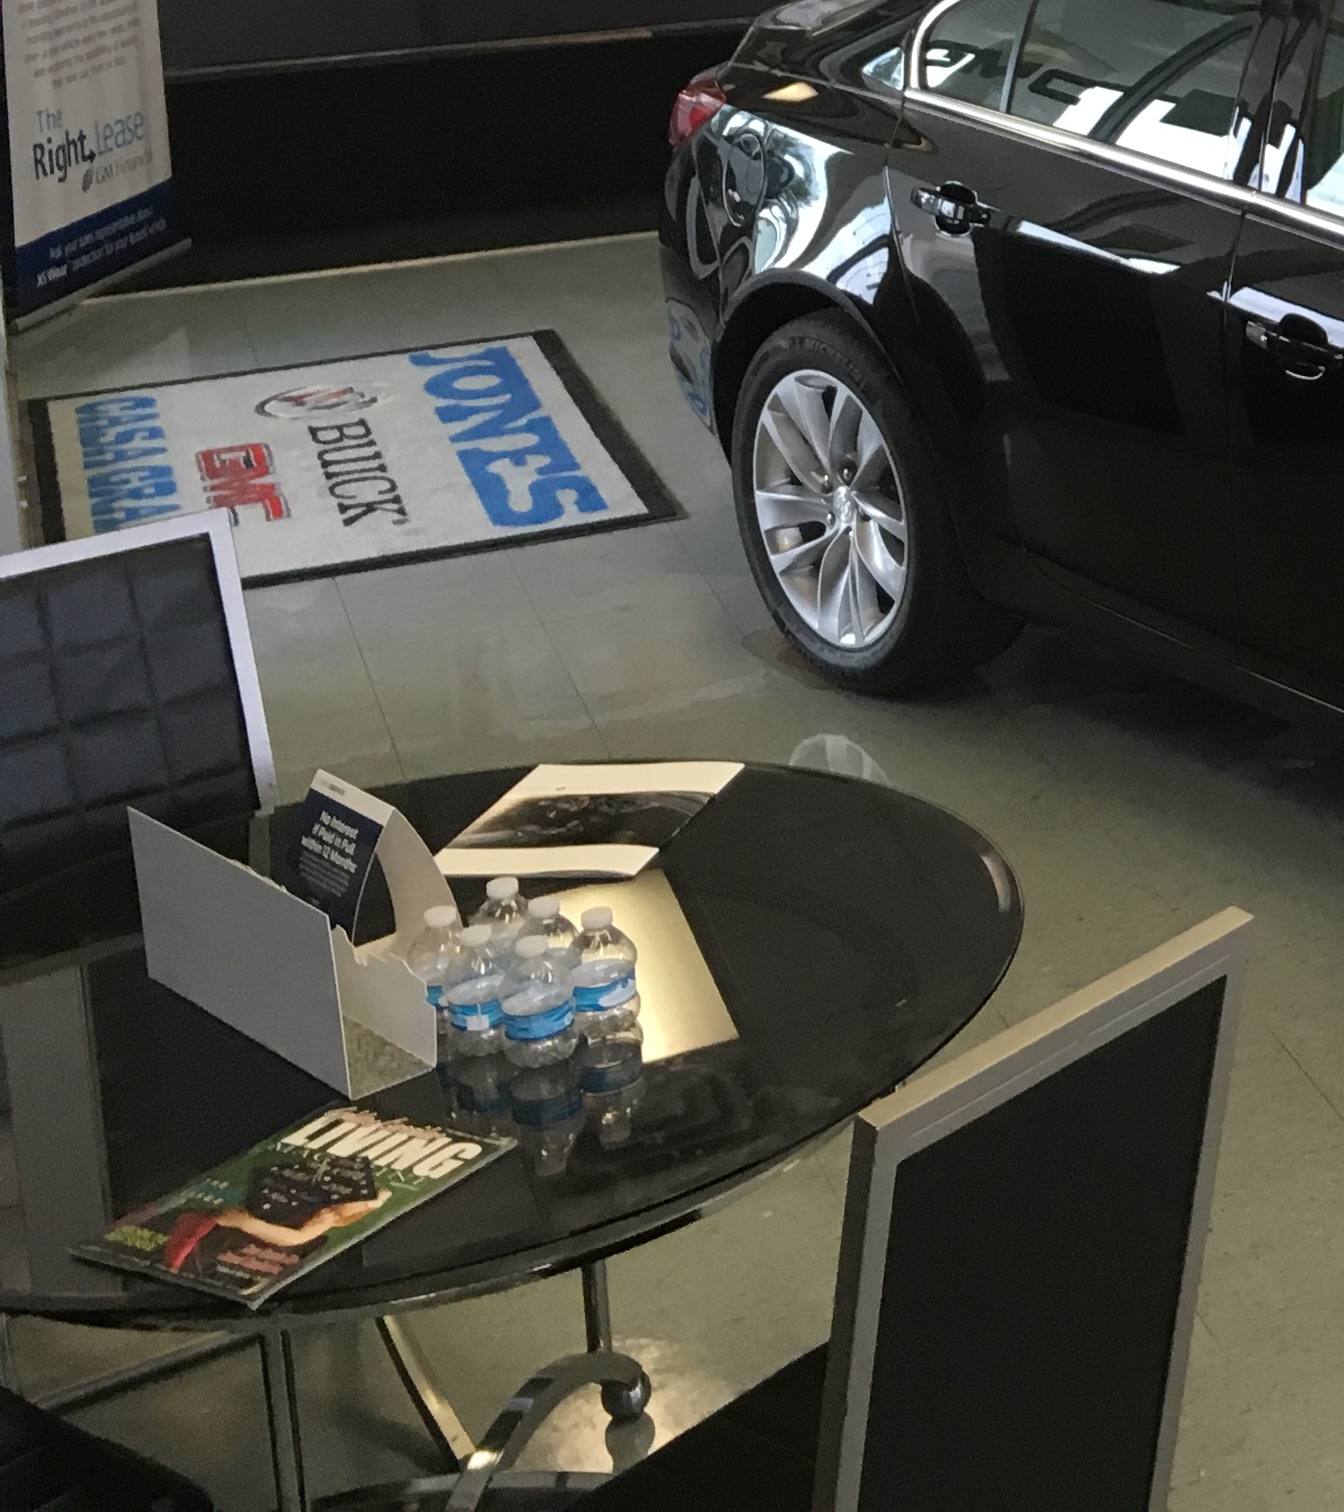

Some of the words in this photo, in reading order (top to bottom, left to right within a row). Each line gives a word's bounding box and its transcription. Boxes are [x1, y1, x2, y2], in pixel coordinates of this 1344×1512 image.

[32, 128, 88, 184] Right
[95, 111, 144, 156] Lease
[35, 106, 63, 133] The
[75, 395, 170, 471] CASA
[408, 346, 609, 528] JONES
[87, 464, 183, 535] GRA
[308, 418, 406, 528] BUICK
[278, 1116, 484, 1180] LIVING
